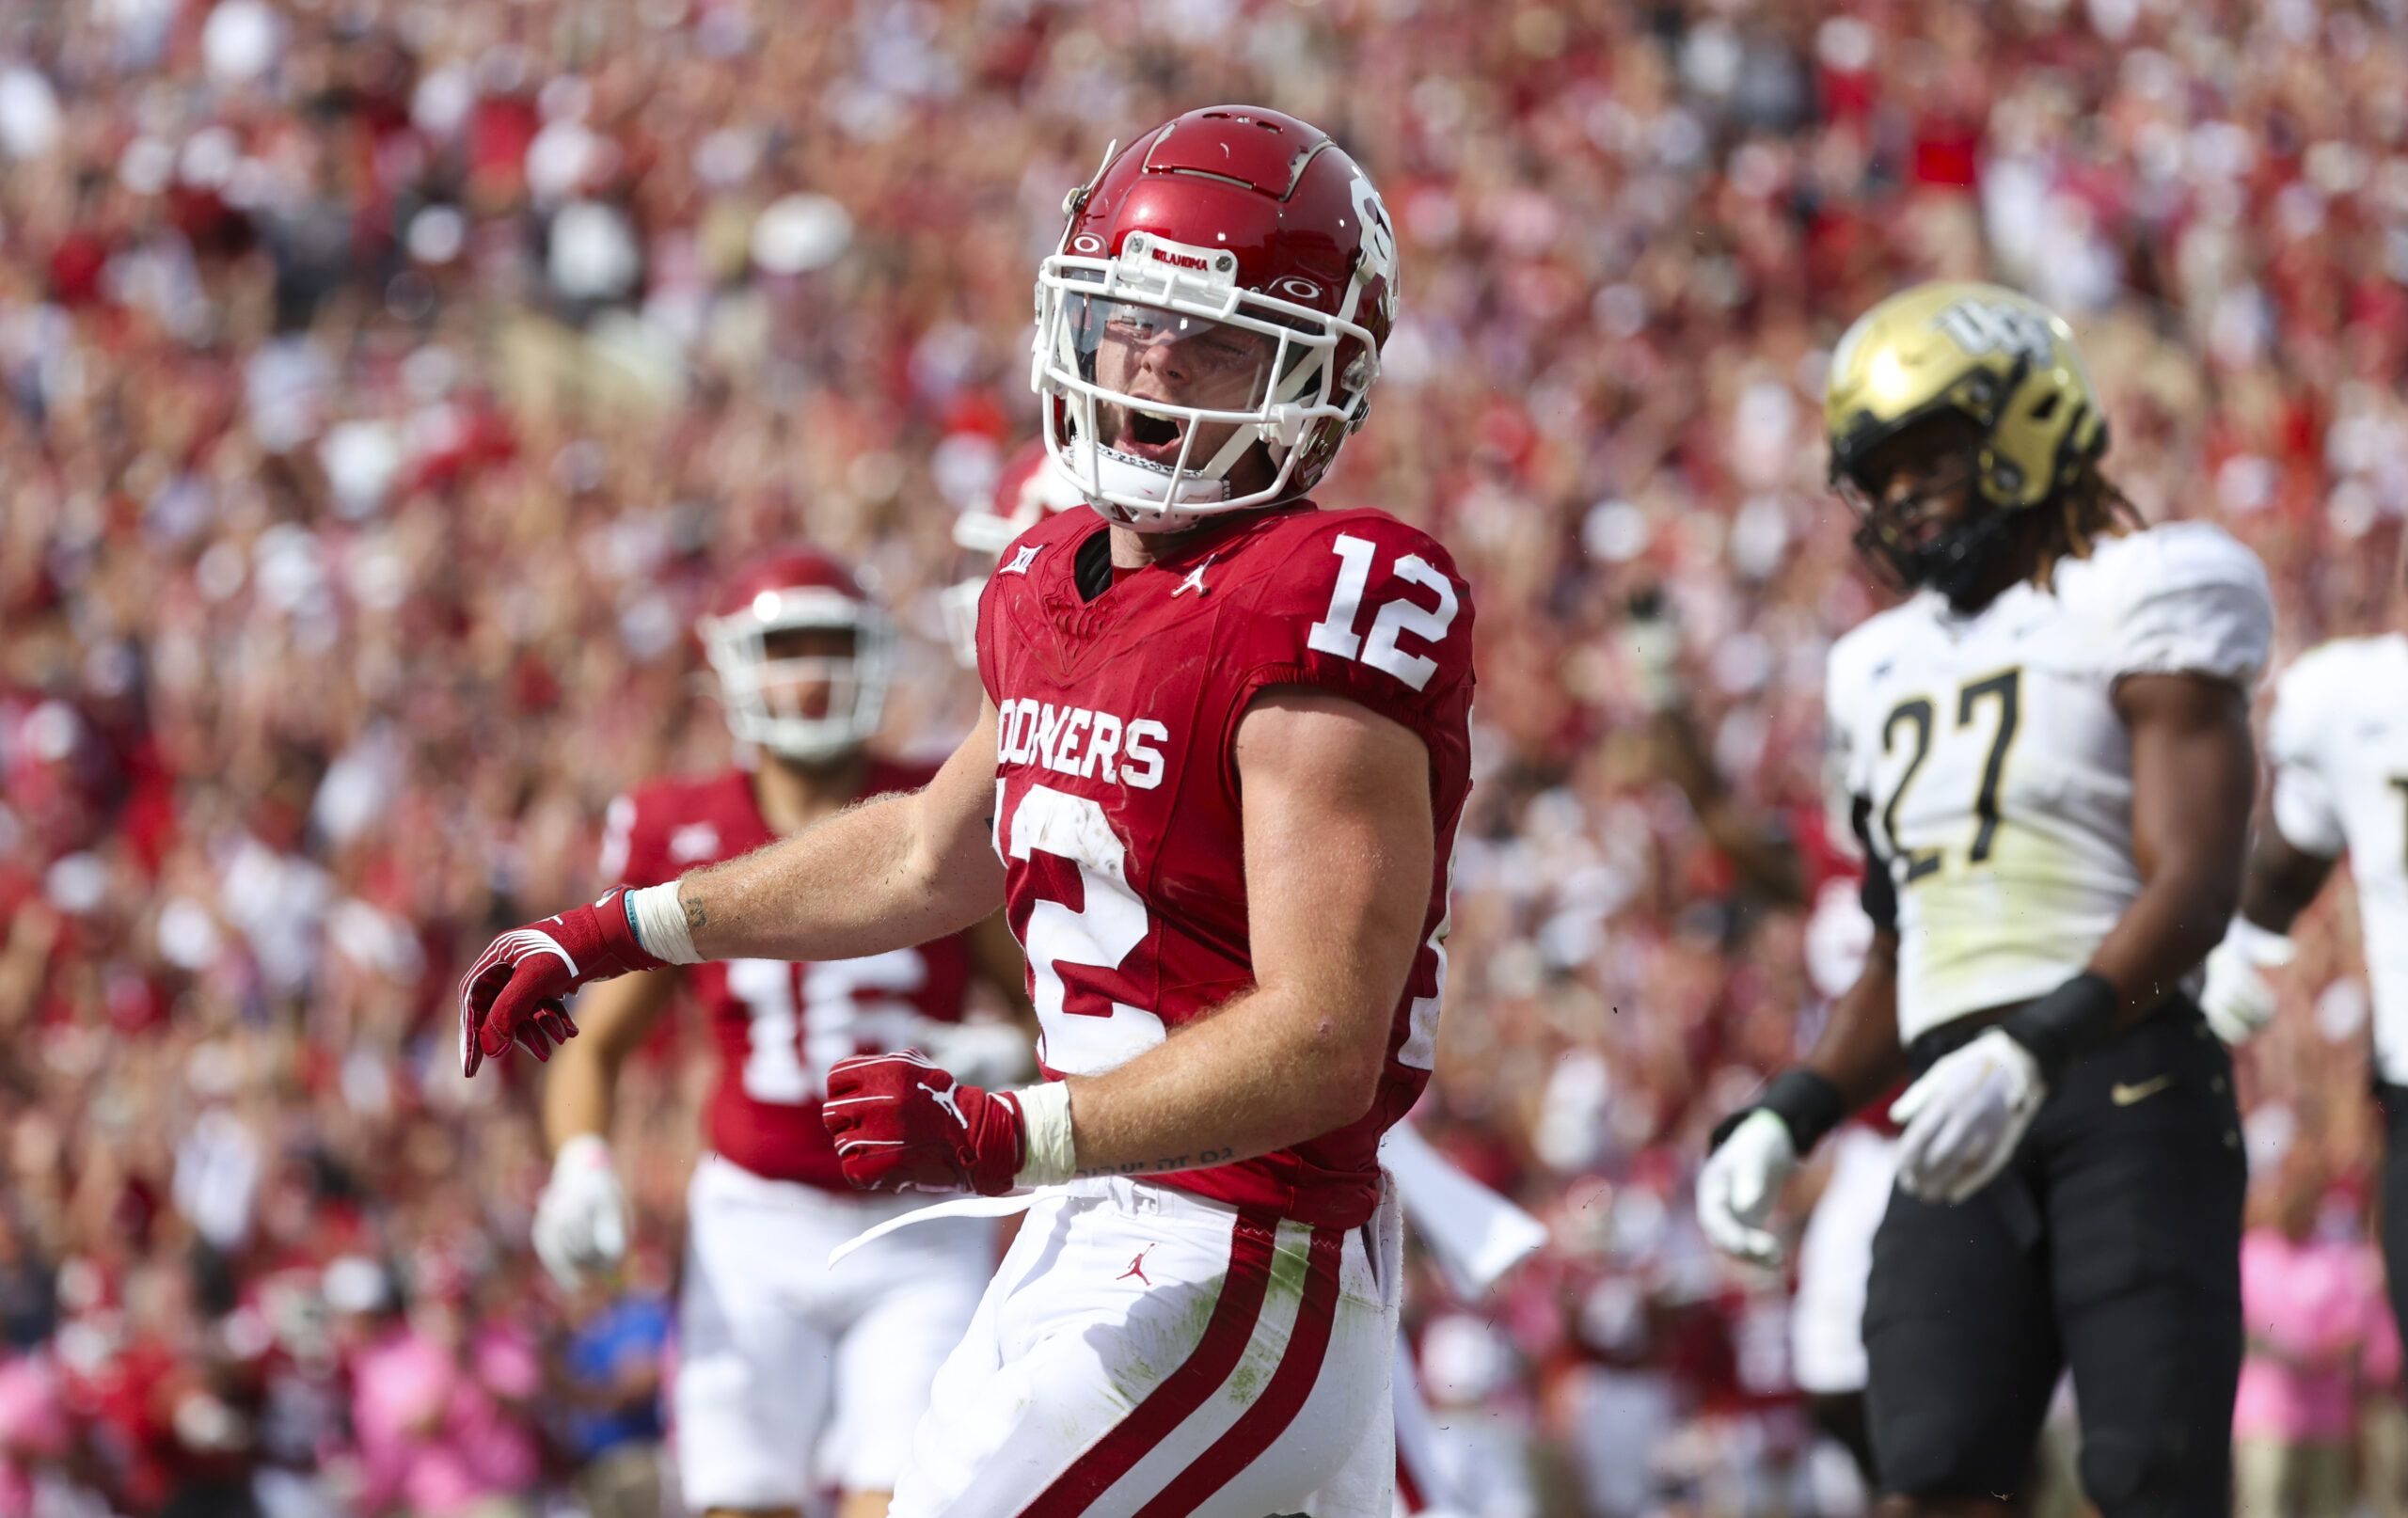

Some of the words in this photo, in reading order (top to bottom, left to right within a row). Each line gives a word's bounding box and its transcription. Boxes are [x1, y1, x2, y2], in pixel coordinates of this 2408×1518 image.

[1152, 247, 1209, 272] OKLAHOMA
[1307, 533, 1458, 692] 12
[997, 697, 1169, 790] OONERS
[1881, 666, 2022, 884] 27
